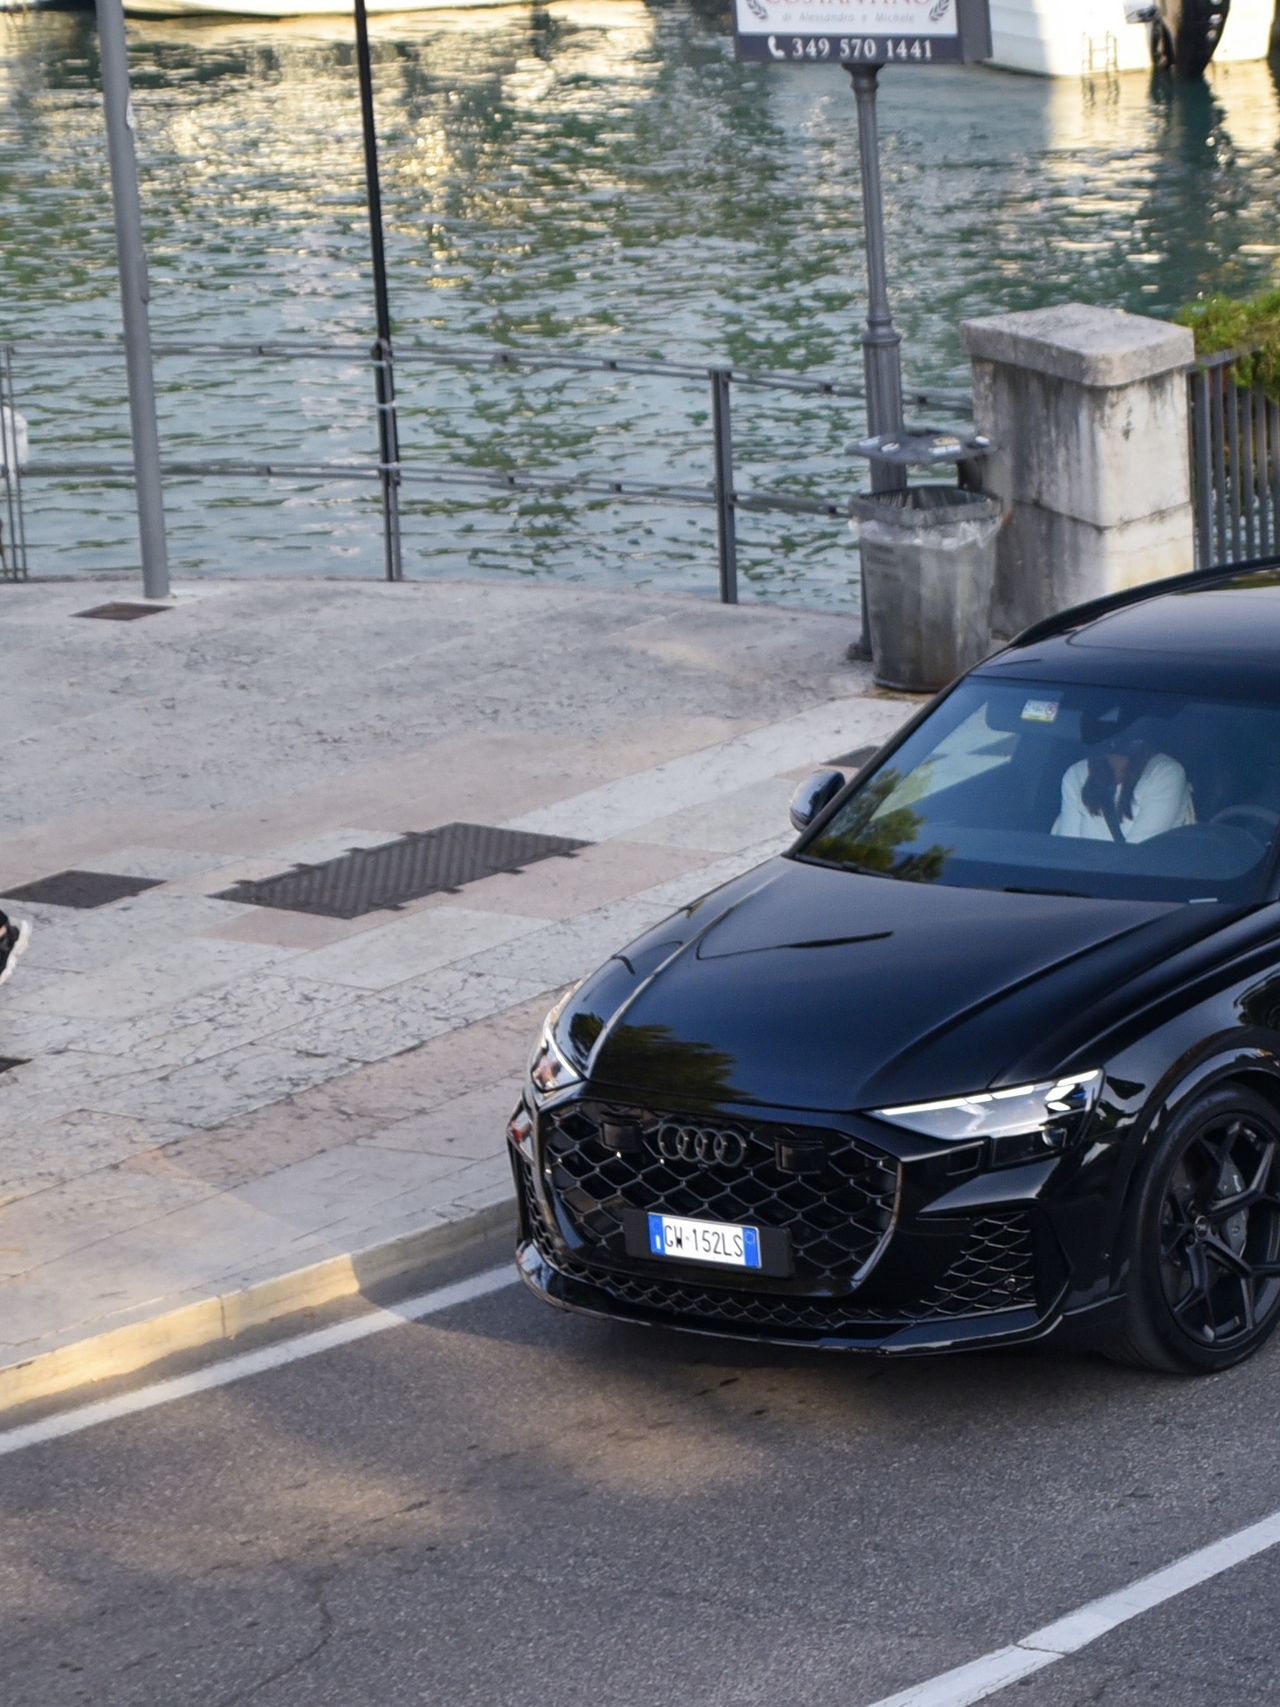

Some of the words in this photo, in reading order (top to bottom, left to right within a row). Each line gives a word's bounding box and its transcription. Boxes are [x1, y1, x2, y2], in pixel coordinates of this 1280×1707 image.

[799, 11, 854, 22] Alessandro
[875, 12, 915, 22] Michele
[792, 37, 830, 57] 349
[840, 38, 876, 58] 570
[886, 38, 932, 59] 1441
